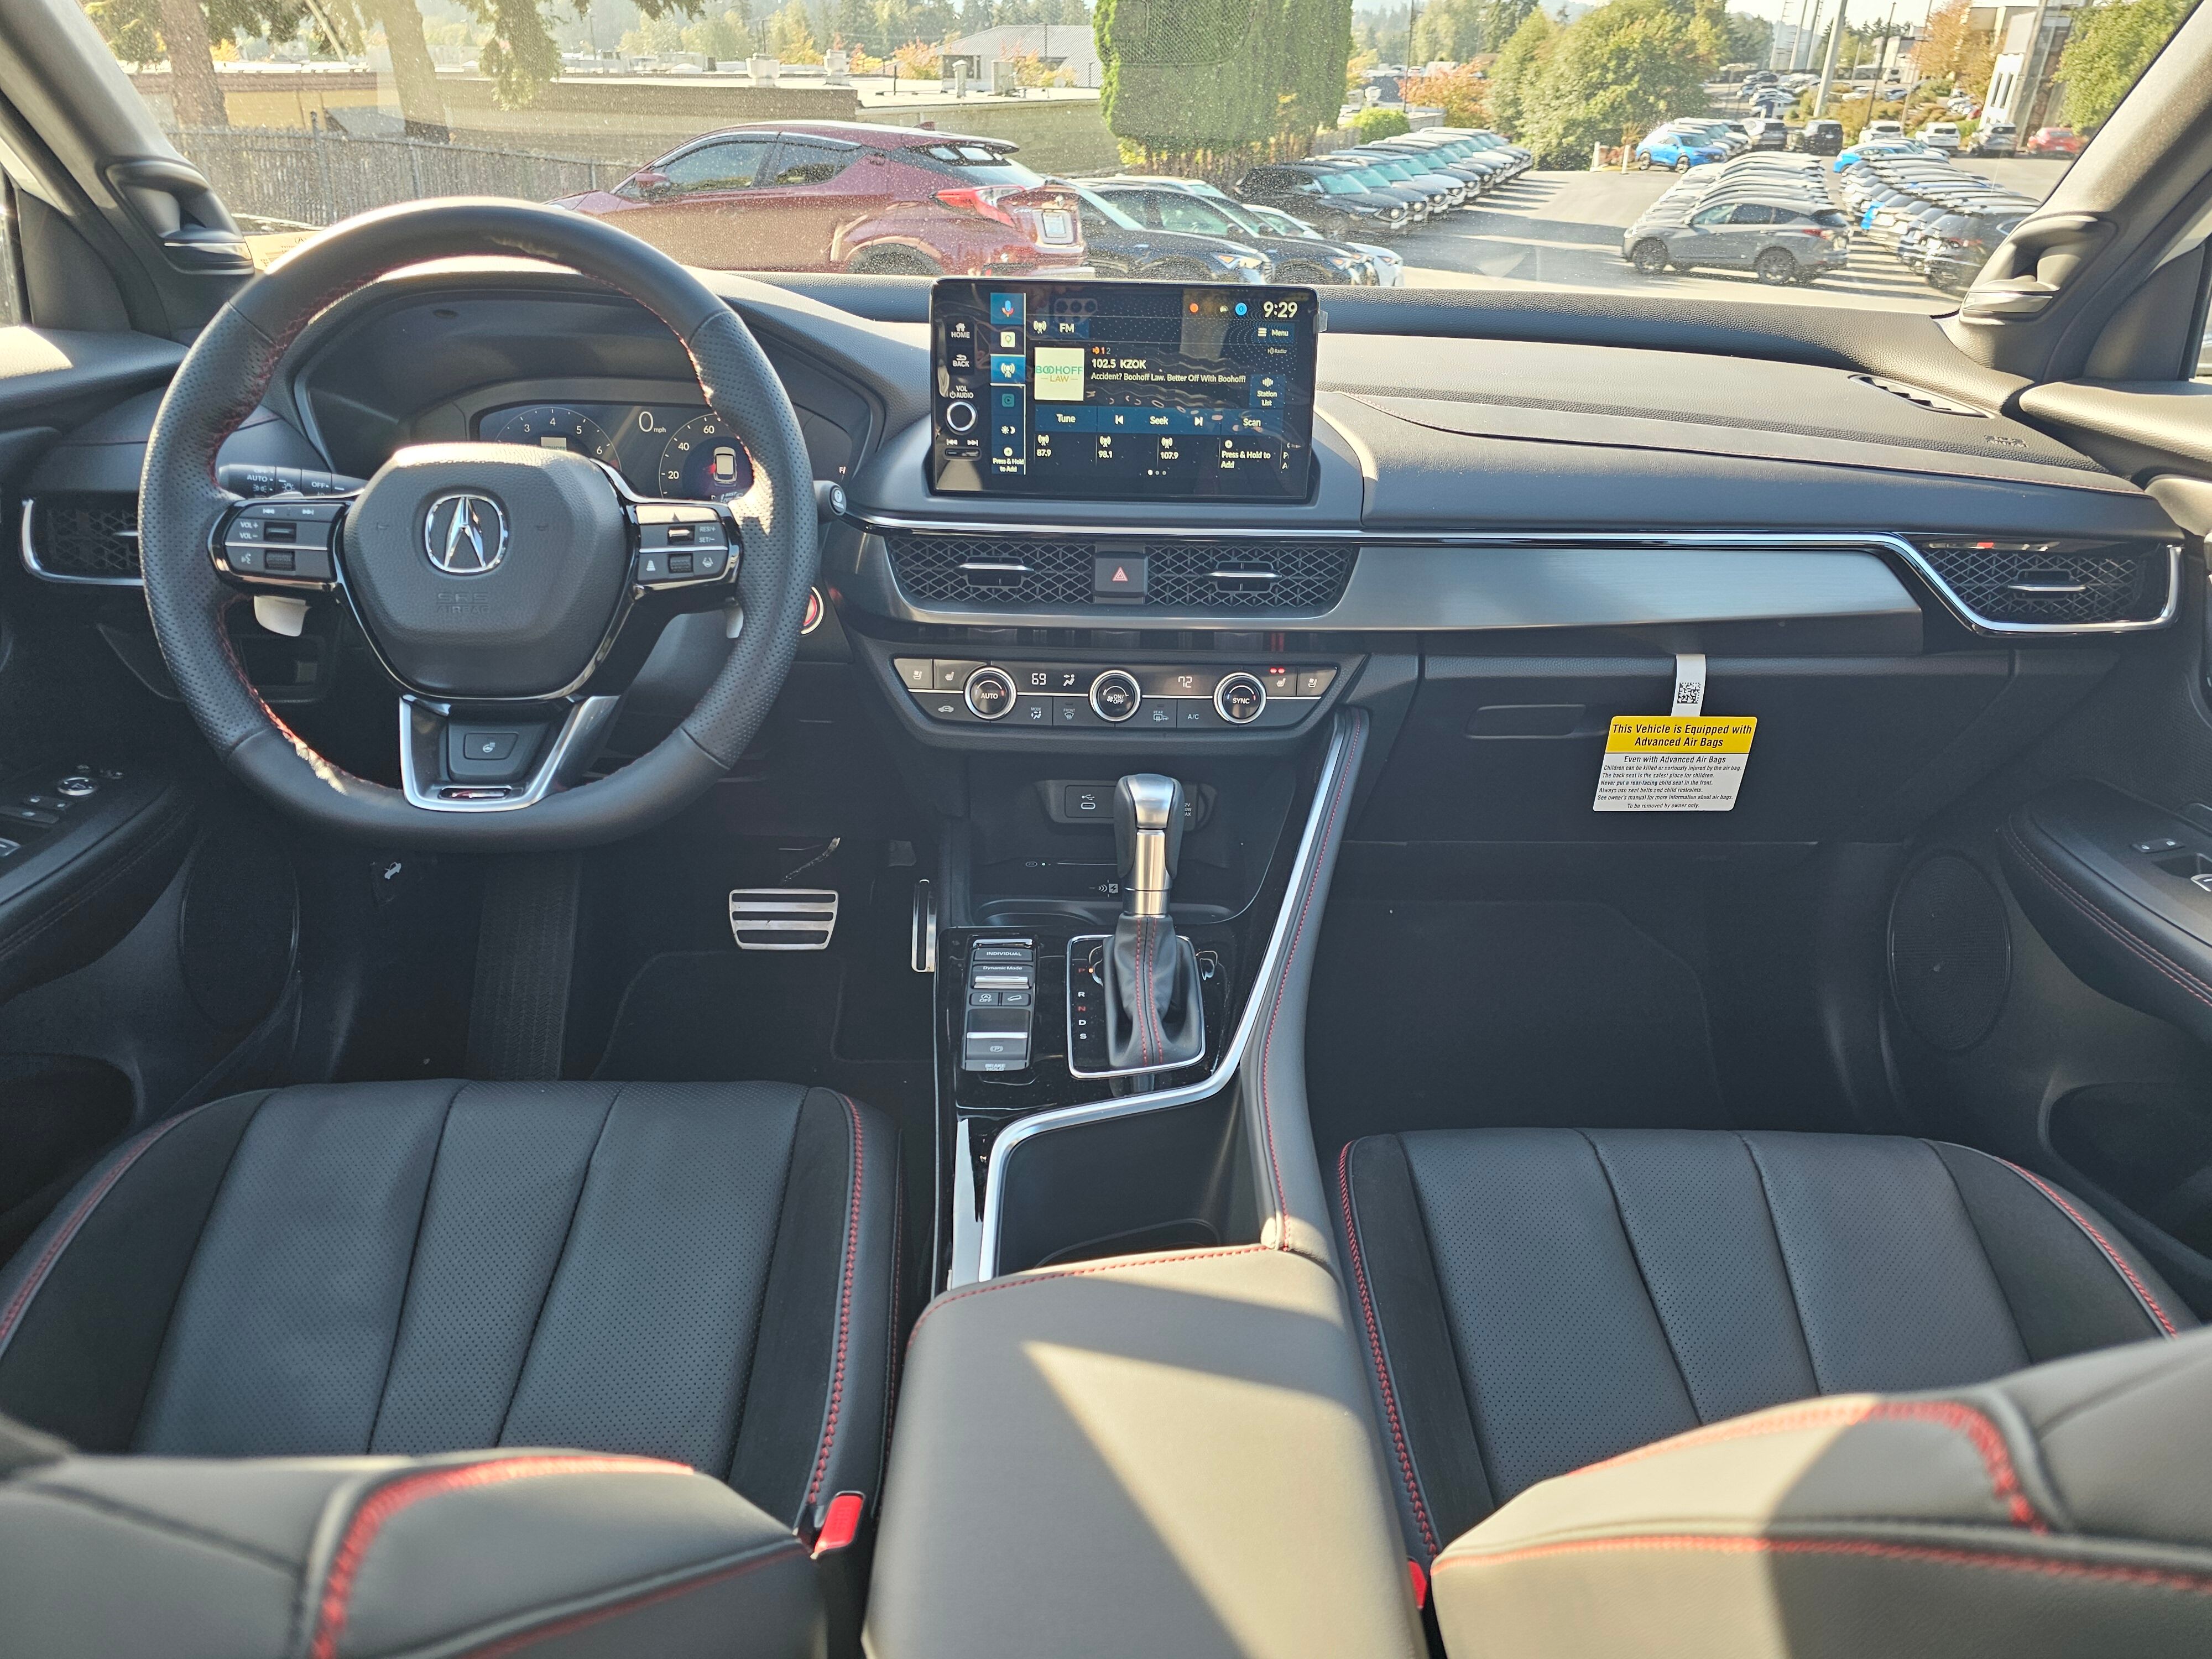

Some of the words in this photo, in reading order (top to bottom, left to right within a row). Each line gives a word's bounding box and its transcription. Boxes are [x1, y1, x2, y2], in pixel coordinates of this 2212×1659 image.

[1263, 301, 1298, 318] 9:29
[1059, 323, 1074, 333] FM
[1091, 358, 1117, 368] 102.5
[1120, 359, 1146, 369] KZOK
[1035, 365, 1083, 374] BOOHOFF
[1091, 372, 1122, 380] Accident?
[1123, 373, 1150, 381] Boohoff
[1151, 373, 1166, 382] Law.
[1167, 373, 1187, 382] Better
[1188, 374, 1199, 382] Off
[1218, 375, 1246, 383] Boohoff!
[550, 418, 556, 426] 4
[639, 411, 654, 432] 0
[1056, 414, 1076, 423] Tune
[1150, 416, 1168, 425] Seek
[1243, 418, 1261, 426] Scan
[576, 426, 582, 434] 5
[703, 426, 714, 434] 60
[596, 446, 602, 455] 6
[1036, 449, 1052, 457] 87.9
[1160, 451, 1179, 460] 107.9
[668, 471, 679, 479] 20
[1031, 672, 1046, 685] 69
[1178, 676, 1192, 688] 72
[1613, 724, 1632, 733] This
[1636, 724, 1670, 733] Vehicle
[1673, 724, 1682, 733] is
[1685, 724, 1729, 735] Equipped
[1732, 725, 1752, 734] with
[1635, 737, 1681, 747] Advanced
[1683, 737, 1698, 747] Air
[1700, 738, 1724, 748] Bags
